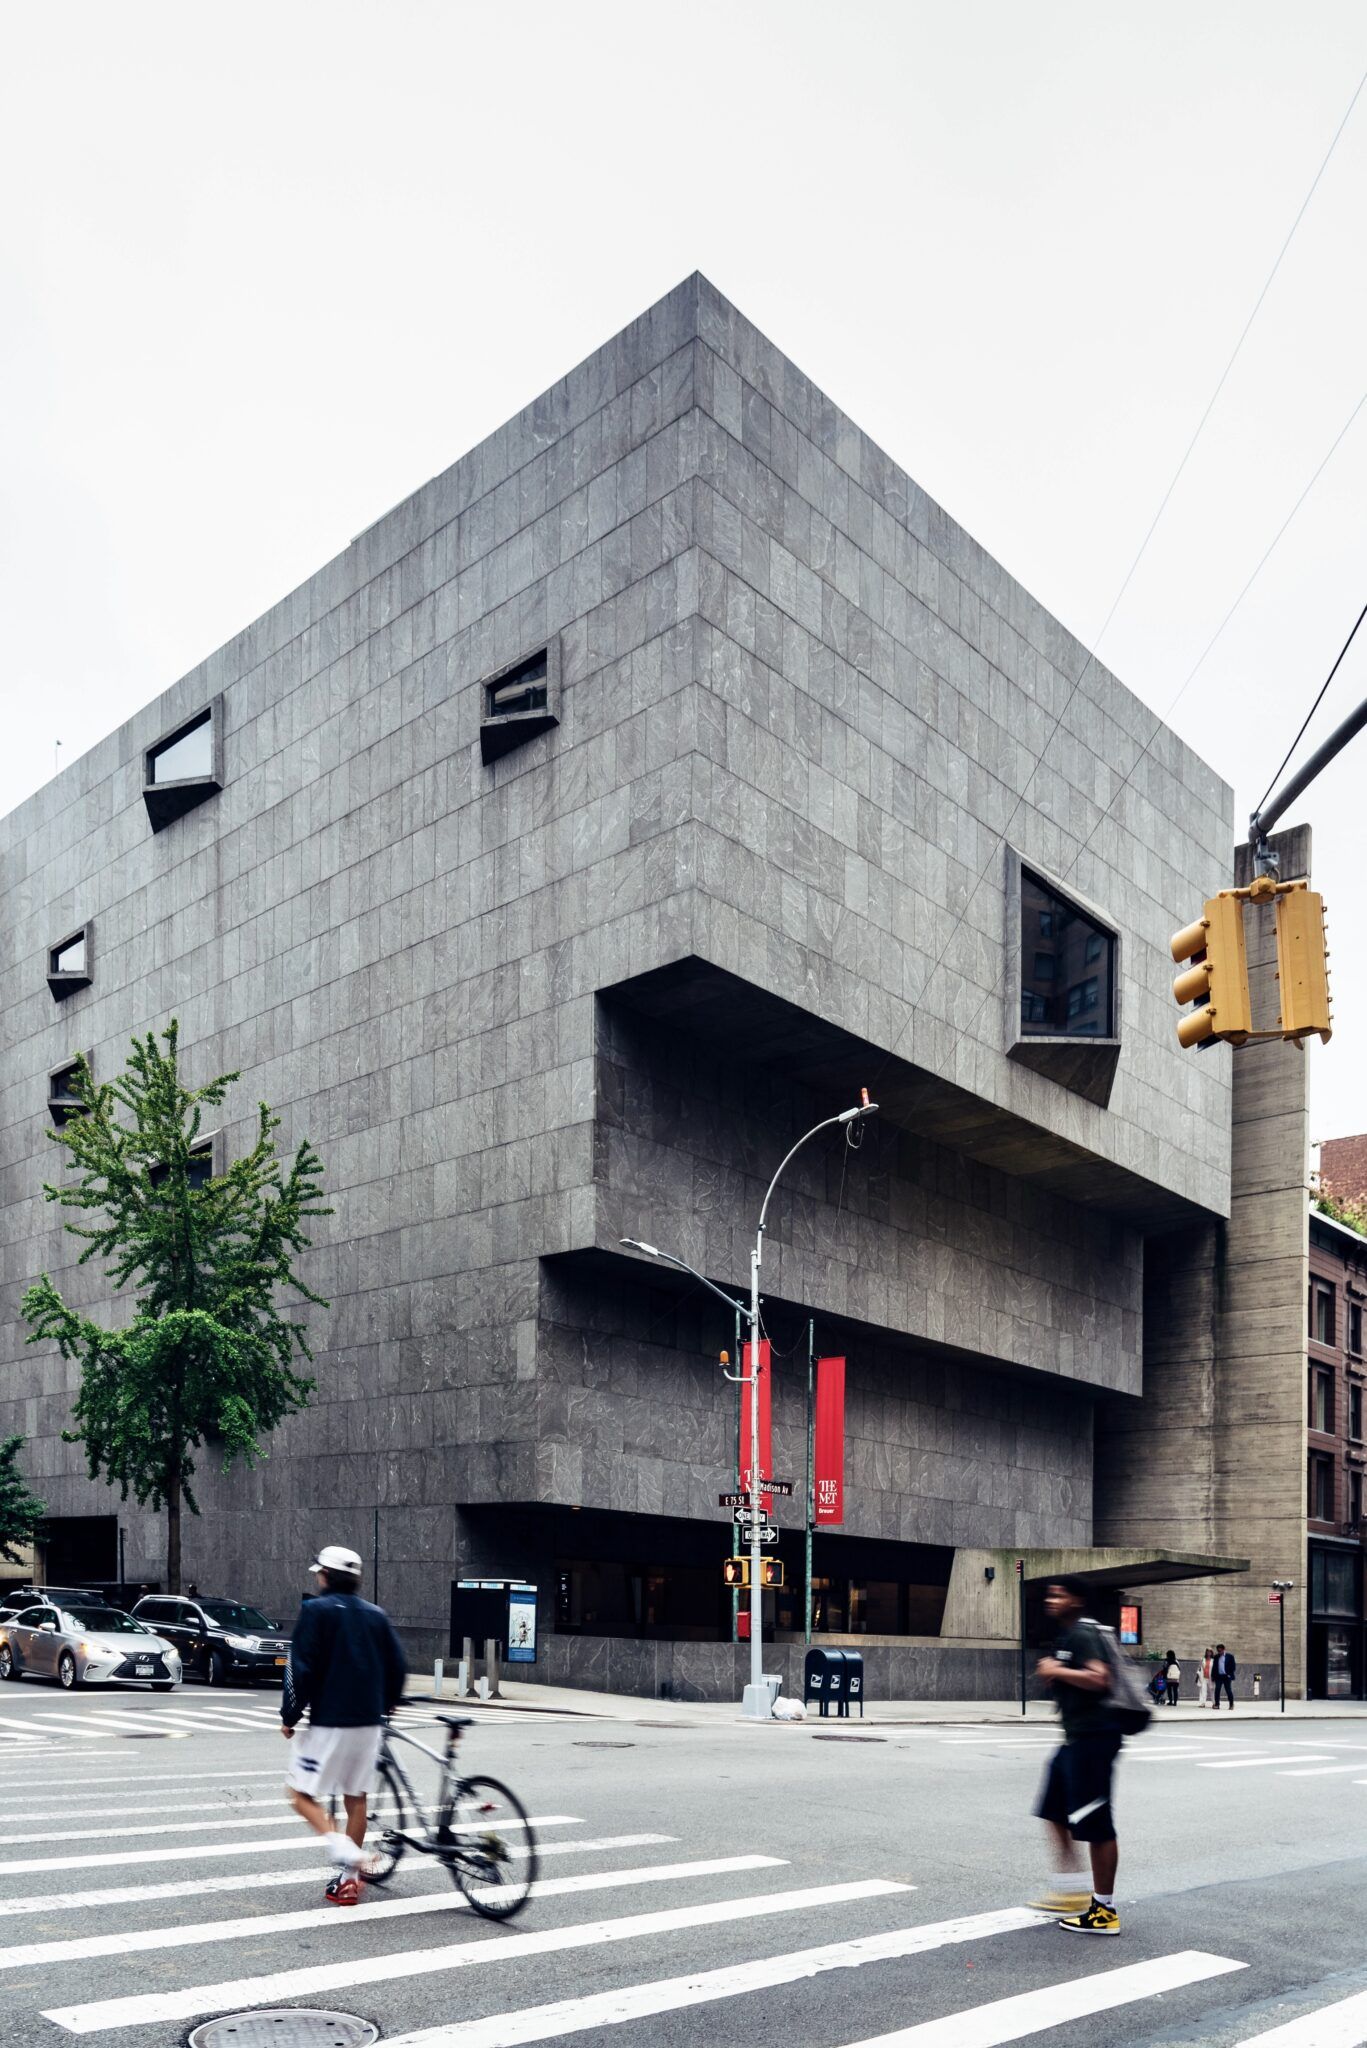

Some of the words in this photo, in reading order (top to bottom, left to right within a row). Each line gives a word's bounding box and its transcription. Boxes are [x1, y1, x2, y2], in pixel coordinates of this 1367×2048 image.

[744, 1470, 765, 1482] TE
[760, 1483, 780, 1493] Madison
[782, 1486, 788, 1494] Av
[819, 1480, 837, 1492] THE
[725, 1497, 728, 1505] E
[731, 1496, 737, 1505] 75
[819, 1493, 837, 1504] MET
